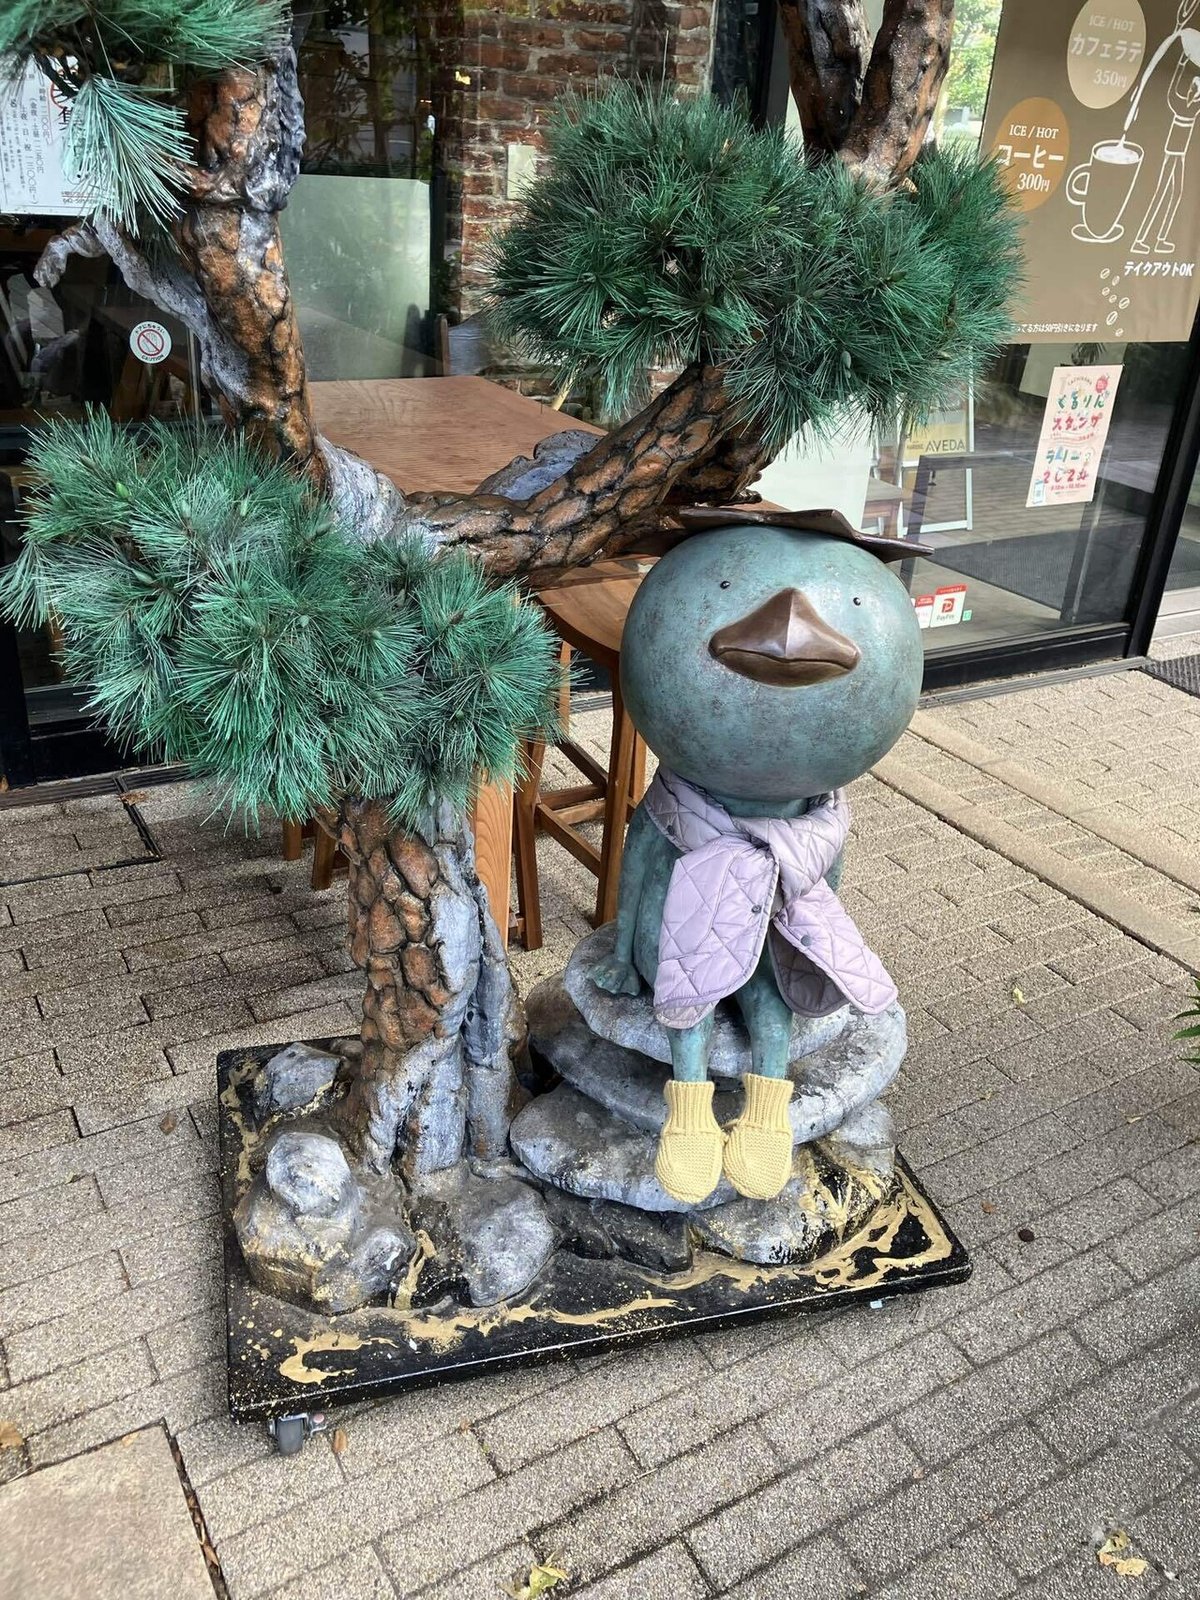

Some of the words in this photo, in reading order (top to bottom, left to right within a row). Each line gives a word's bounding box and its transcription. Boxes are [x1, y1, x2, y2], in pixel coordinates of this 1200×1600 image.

[1088, 15, 1106, 27] ICE
[1113, 19, 1137, 32] HOT
[1071, 33, 1142, 62] カフェラテ
[1093, 69, 1128, 88] 350円
[1009, 124, 1028, 137] ICE
[1036, 126, 1059, 139] HOT
[996, 144, 1064, 169] コーヒー
[1017, 172, 1051, 192] 300円
[1124, 261, 1195, 277] テイクアウトOK
[1013, 322, 1099, 333] ってる方は50円引きになります
[141, 354, 164, 363] CAUTION
[1057, 390, 1105, 410] くるりん
[925, 439, 966, 453] AVEDA
